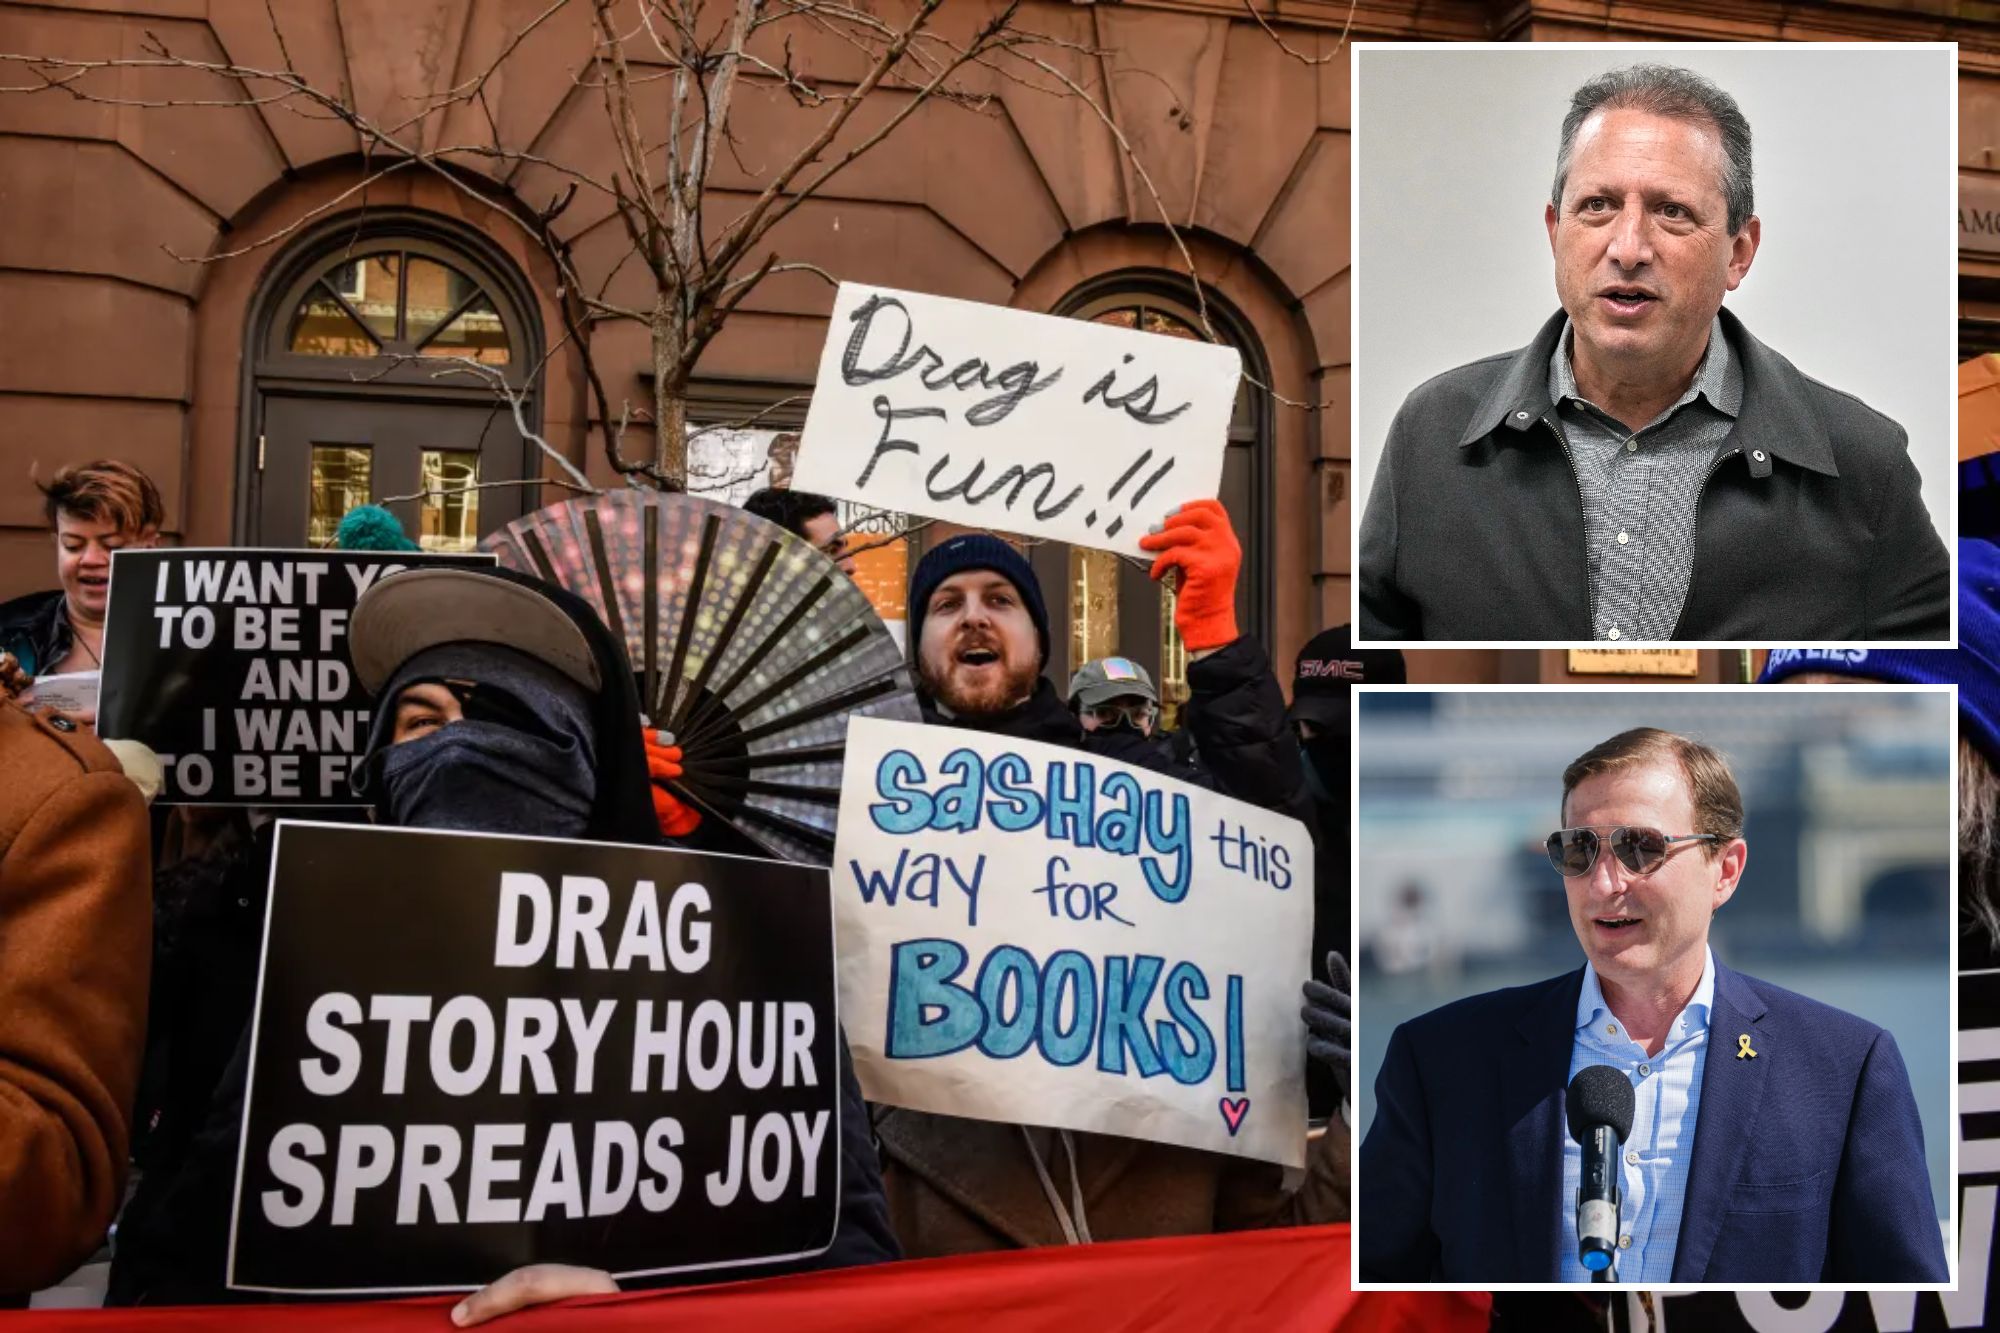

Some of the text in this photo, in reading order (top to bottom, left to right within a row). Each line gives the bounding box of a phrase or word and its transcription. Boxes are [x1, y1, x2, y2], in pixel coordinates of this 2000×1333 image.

[841, 294, 1192, 426] Drag is
[855, 394, 1175, 538] Fun!!
[155, 561, 170, 602] I
[184, 561, 328, 604] WANT
[154, 607, 216, 650] TO
[234, 608, 299, 651] BE
[241, 658, 350, 702] AND
[1300, 660, 1364, 679] GMC
[203, 709, 216, 750] I
[233, 755, 299, 796] BE
[849, 848, 986, 927] way
[1209, 819, 1292, 890] this
[494, 872, 712, 973] DRAG
[299, 992, 819, 1096] STORY HOUR
[260, 1110, 831, 1228] SPREADS JOY
